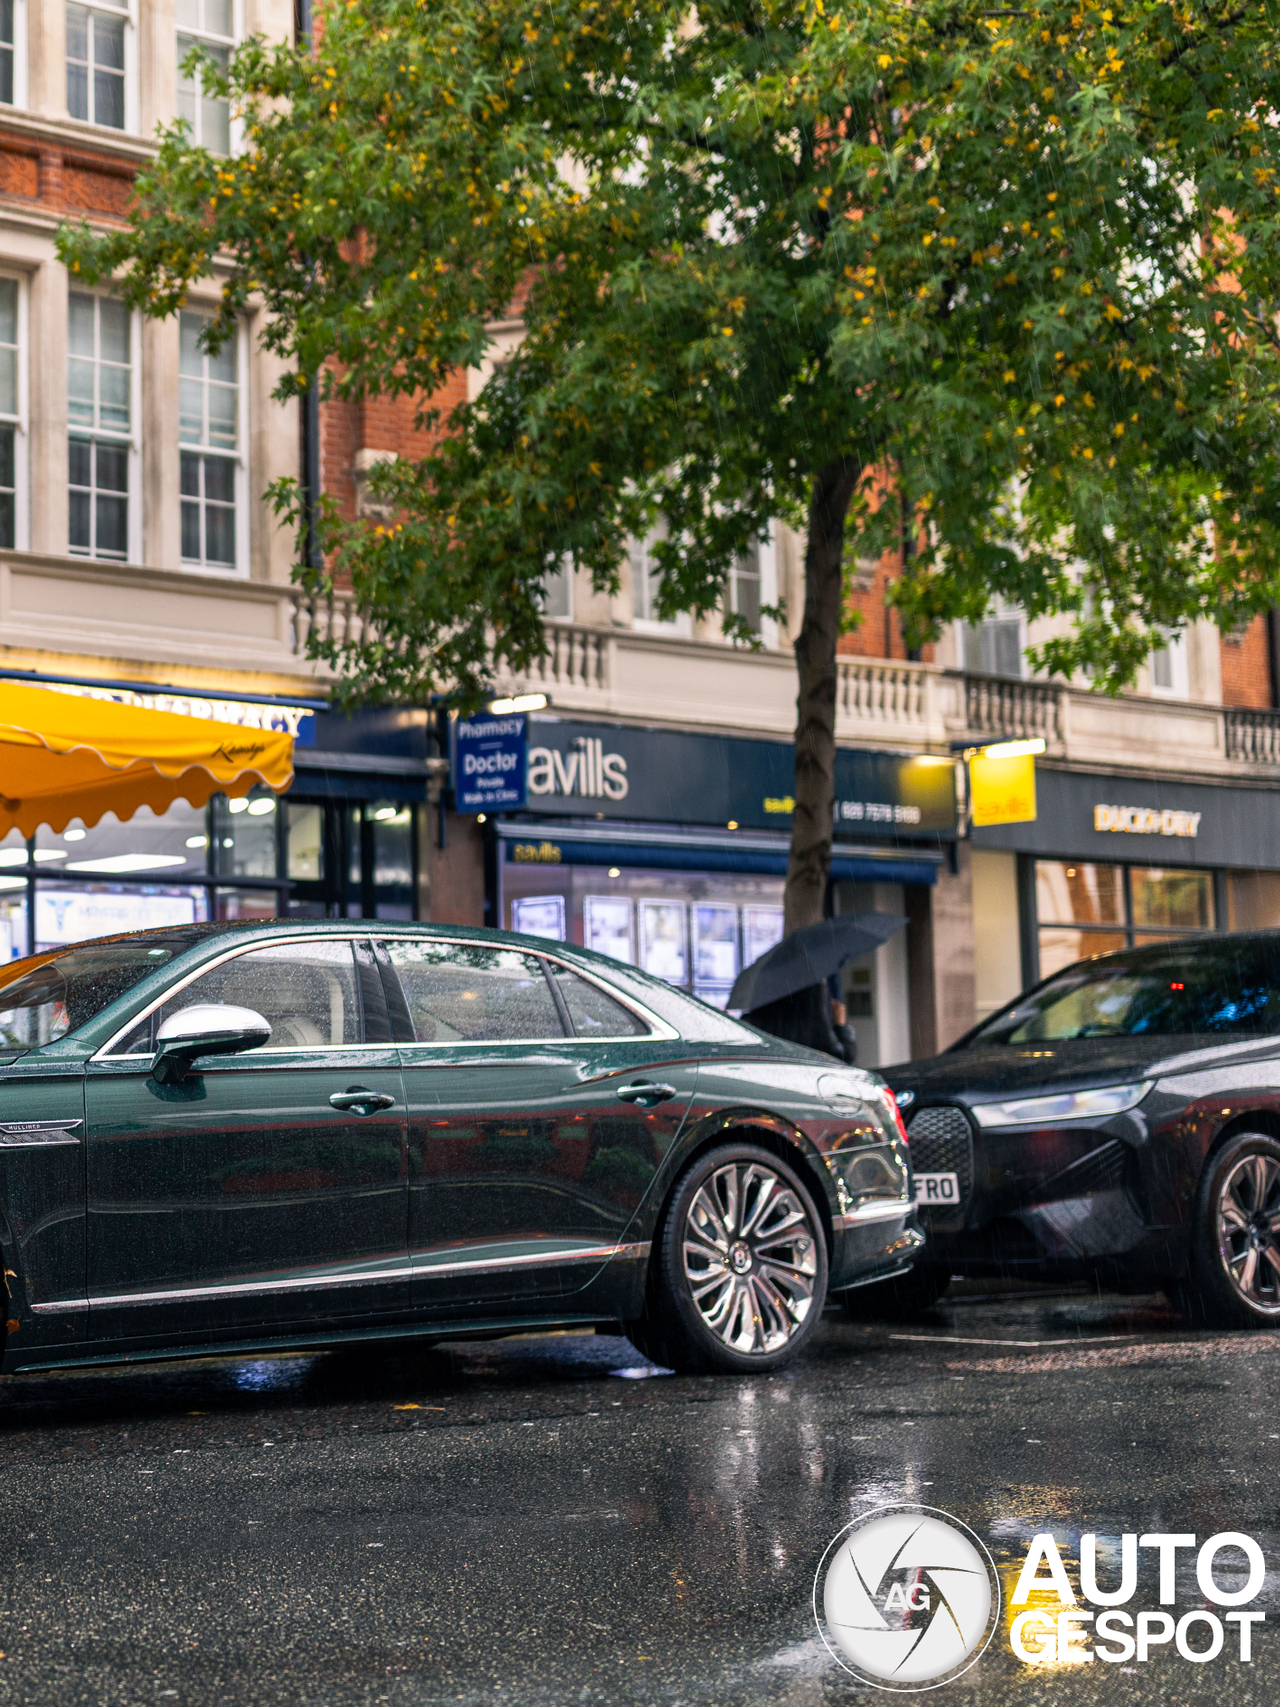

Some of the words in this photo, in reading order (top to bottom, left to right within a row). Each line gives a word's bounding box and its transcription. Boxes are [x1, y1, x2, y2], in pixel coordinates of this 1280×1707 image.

[460, 718, 524, 739] Pharmacy
[464, 752, 518, 775] Doctor
[528, 736, 629, 800] avills
[913, 1178, 954, 1199] FRO
